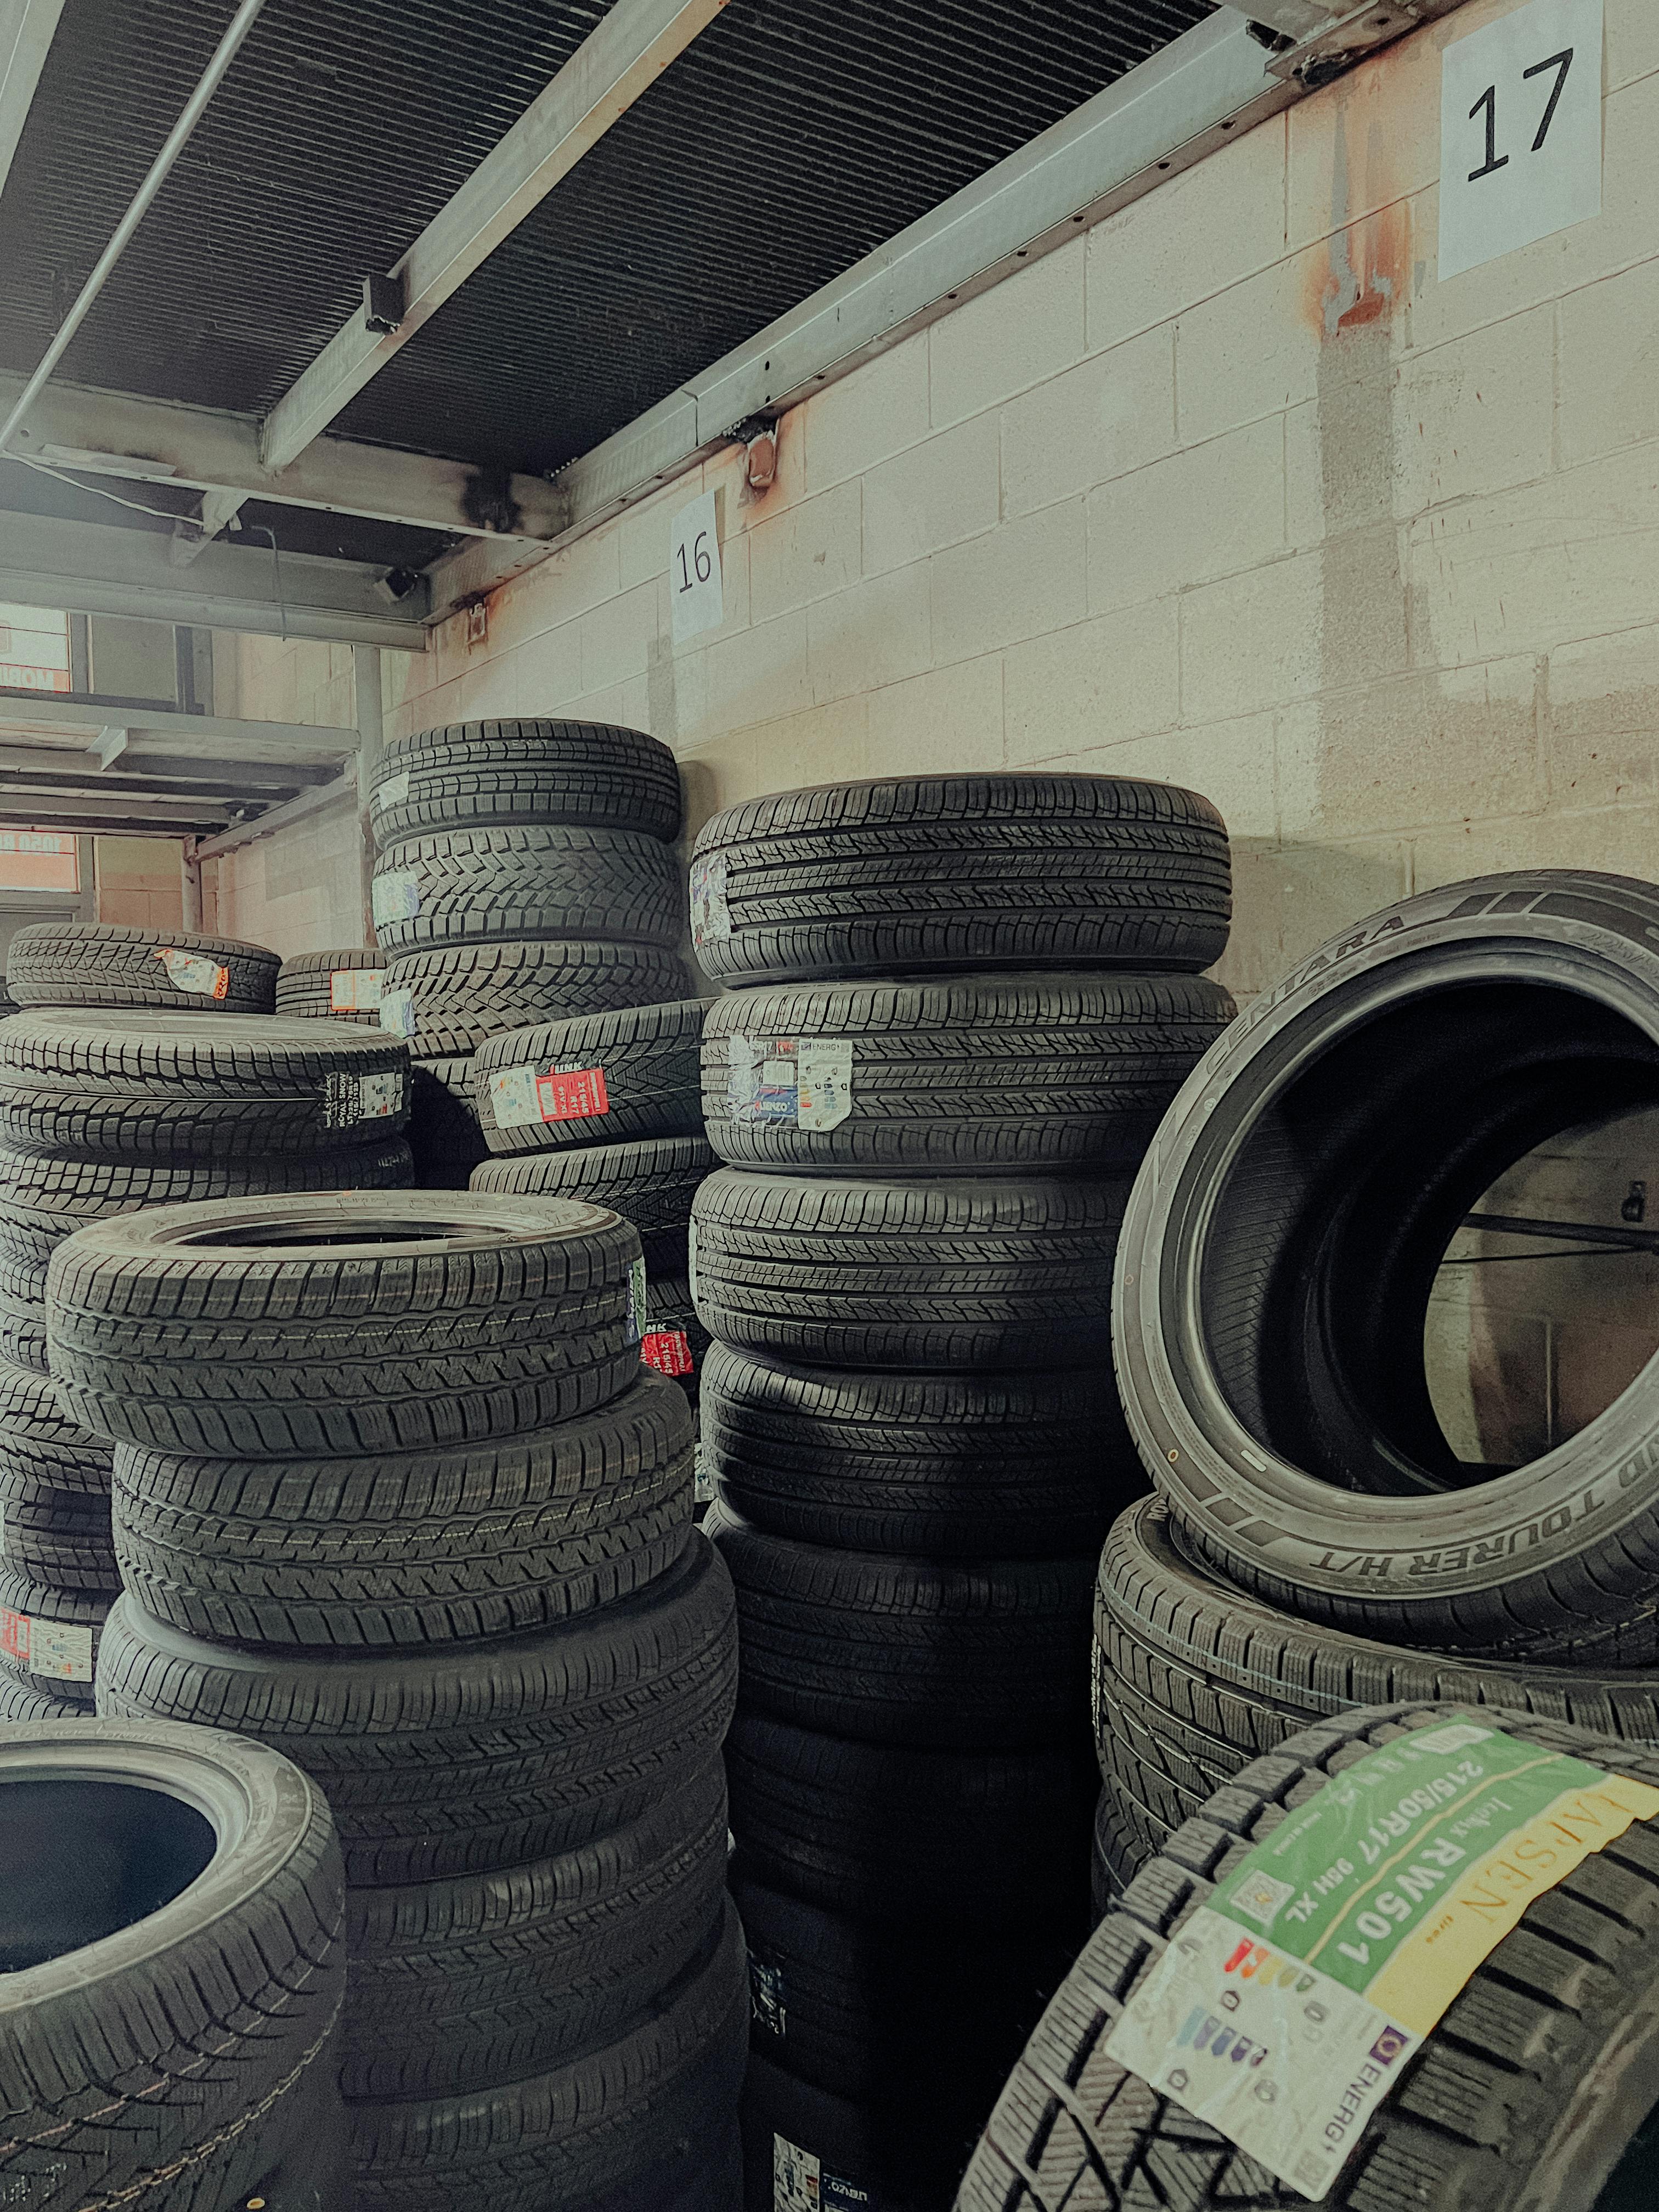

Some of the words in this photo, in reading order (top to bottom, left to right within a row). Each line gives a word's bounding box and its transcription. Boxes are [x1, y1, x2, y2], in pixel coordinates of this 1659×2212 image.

[1468, 47, 1573, 182] 17
[677, 531, 710, 593] 16
[1206, 914, 1406, 1074] CENTARA
[338, 1102, 347, 1127] ROYAL
[571, 1096, 579, 1114] R17
[1309, 1549, 1392, 1577] H/T
[1408, 1488, 1604, 1576] TOURER
[1357, 1760, 1484, 1864] 215/50R17
[1285, 1891, 1319, 1923] XL
[1337, 1836, 1467, 1966] RW501
[1325, 2062, 1383, 2151] ENERG
